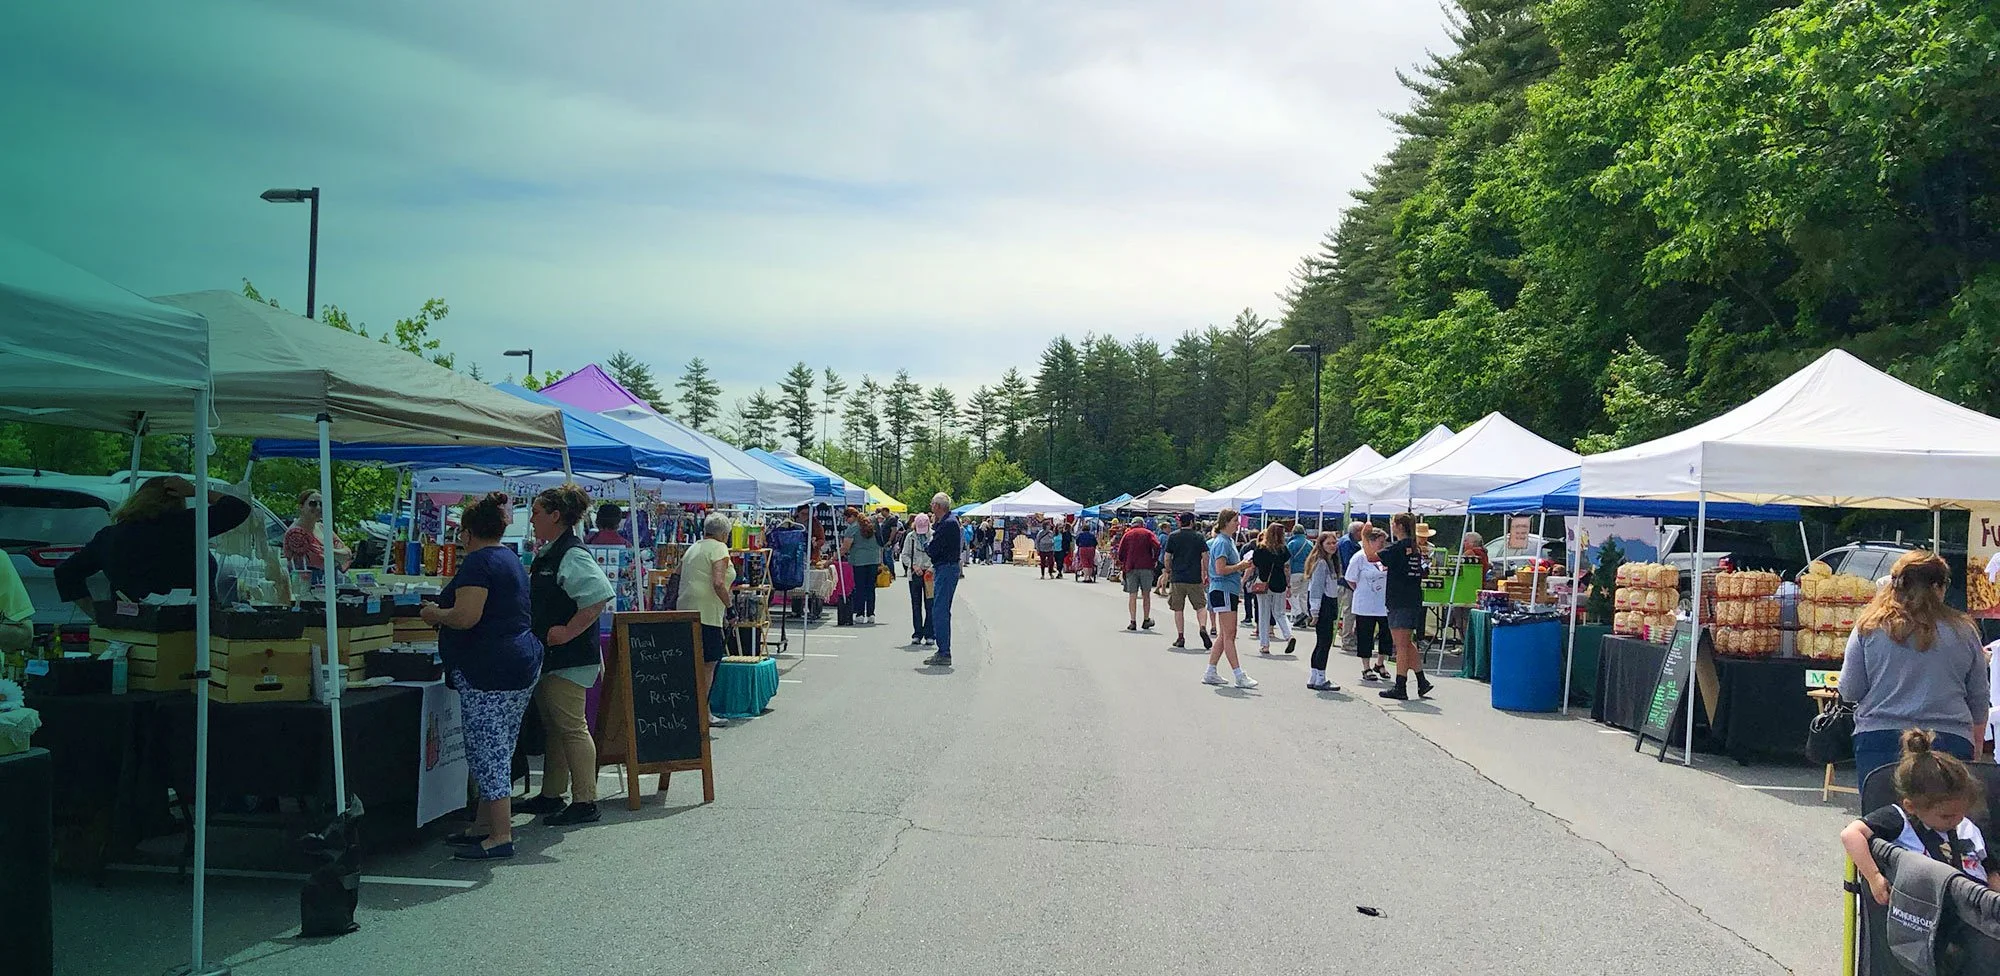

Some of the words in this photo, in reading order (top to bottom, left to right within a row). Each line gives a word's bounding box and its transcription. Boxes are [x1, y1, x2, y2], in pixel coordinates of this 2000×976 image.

[630, 634, 656, 649] Meal
[640, 648, 683, 665] Recipes
[635, 670, 668, 685] Soup
[650, 689, 690, 709] Recipes
[638, 718, 658, 736] Dry
[659, 713, 687, 731] Rubs
